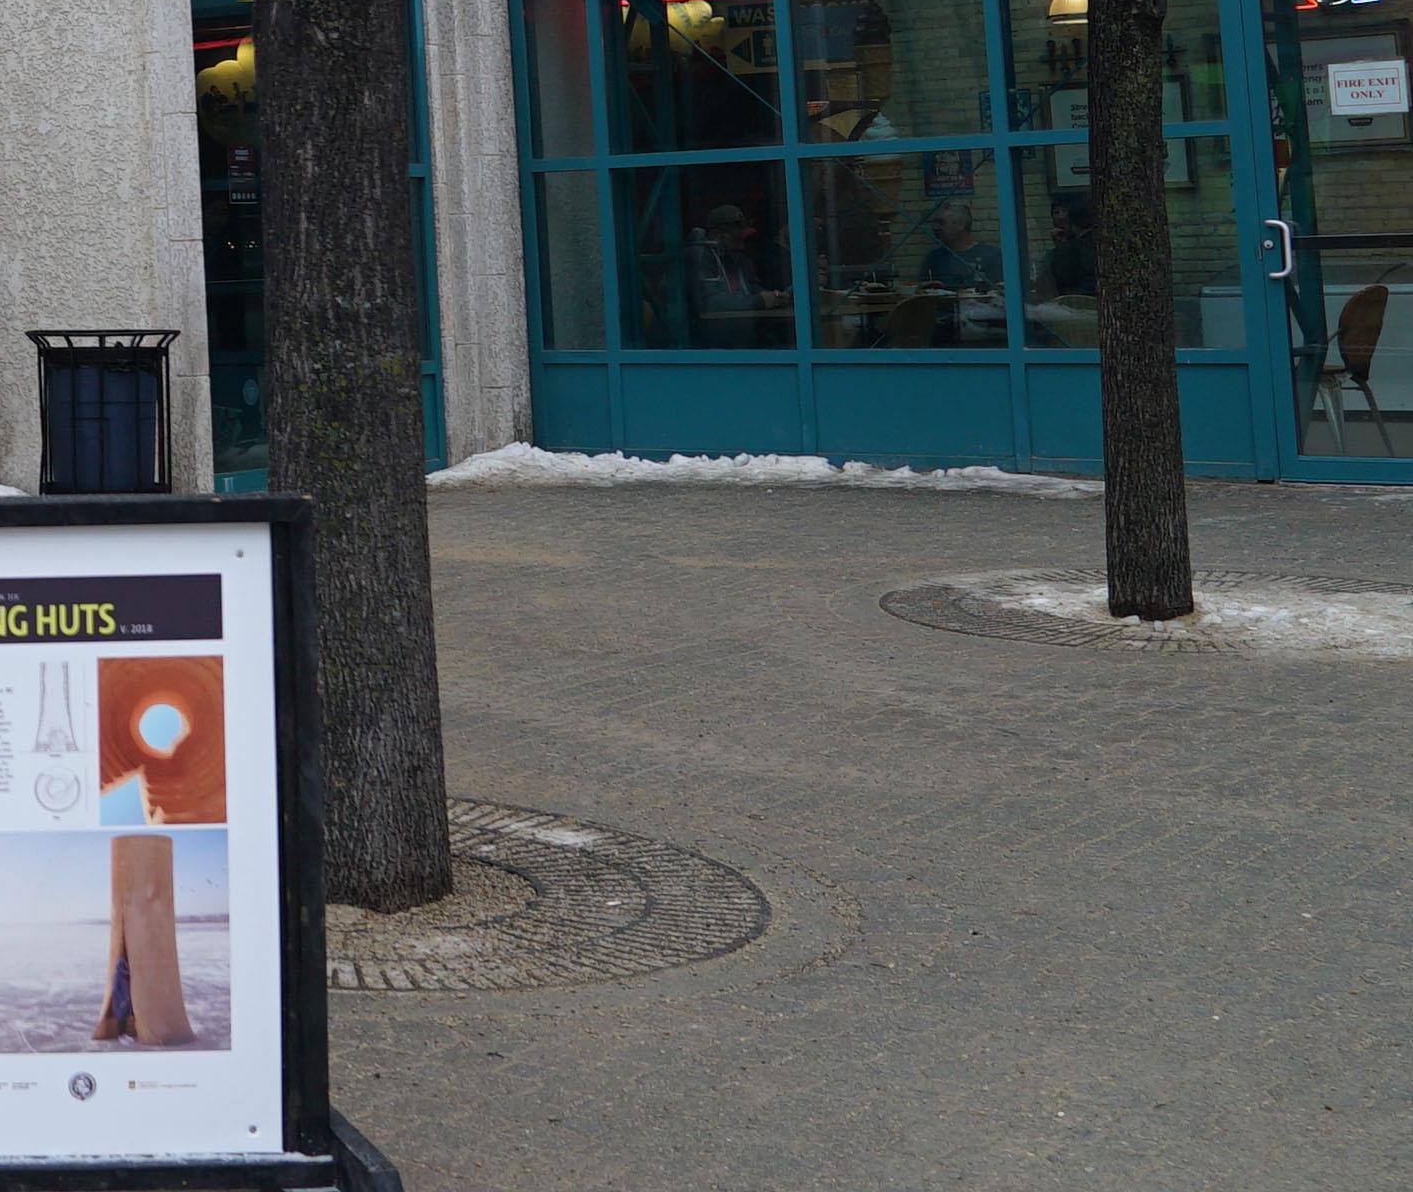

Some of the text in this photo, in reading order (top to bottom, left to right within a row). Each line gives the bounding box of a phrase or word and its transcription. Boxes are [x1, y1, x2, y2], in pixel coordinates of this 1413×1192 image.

[1336, 76, 1398, 88] FIRE EXIT
[1350, 89, 1385, 100] ONLY
[35, 603, 116, 636] HUTS
[130, 623, 153, 635] 2018
